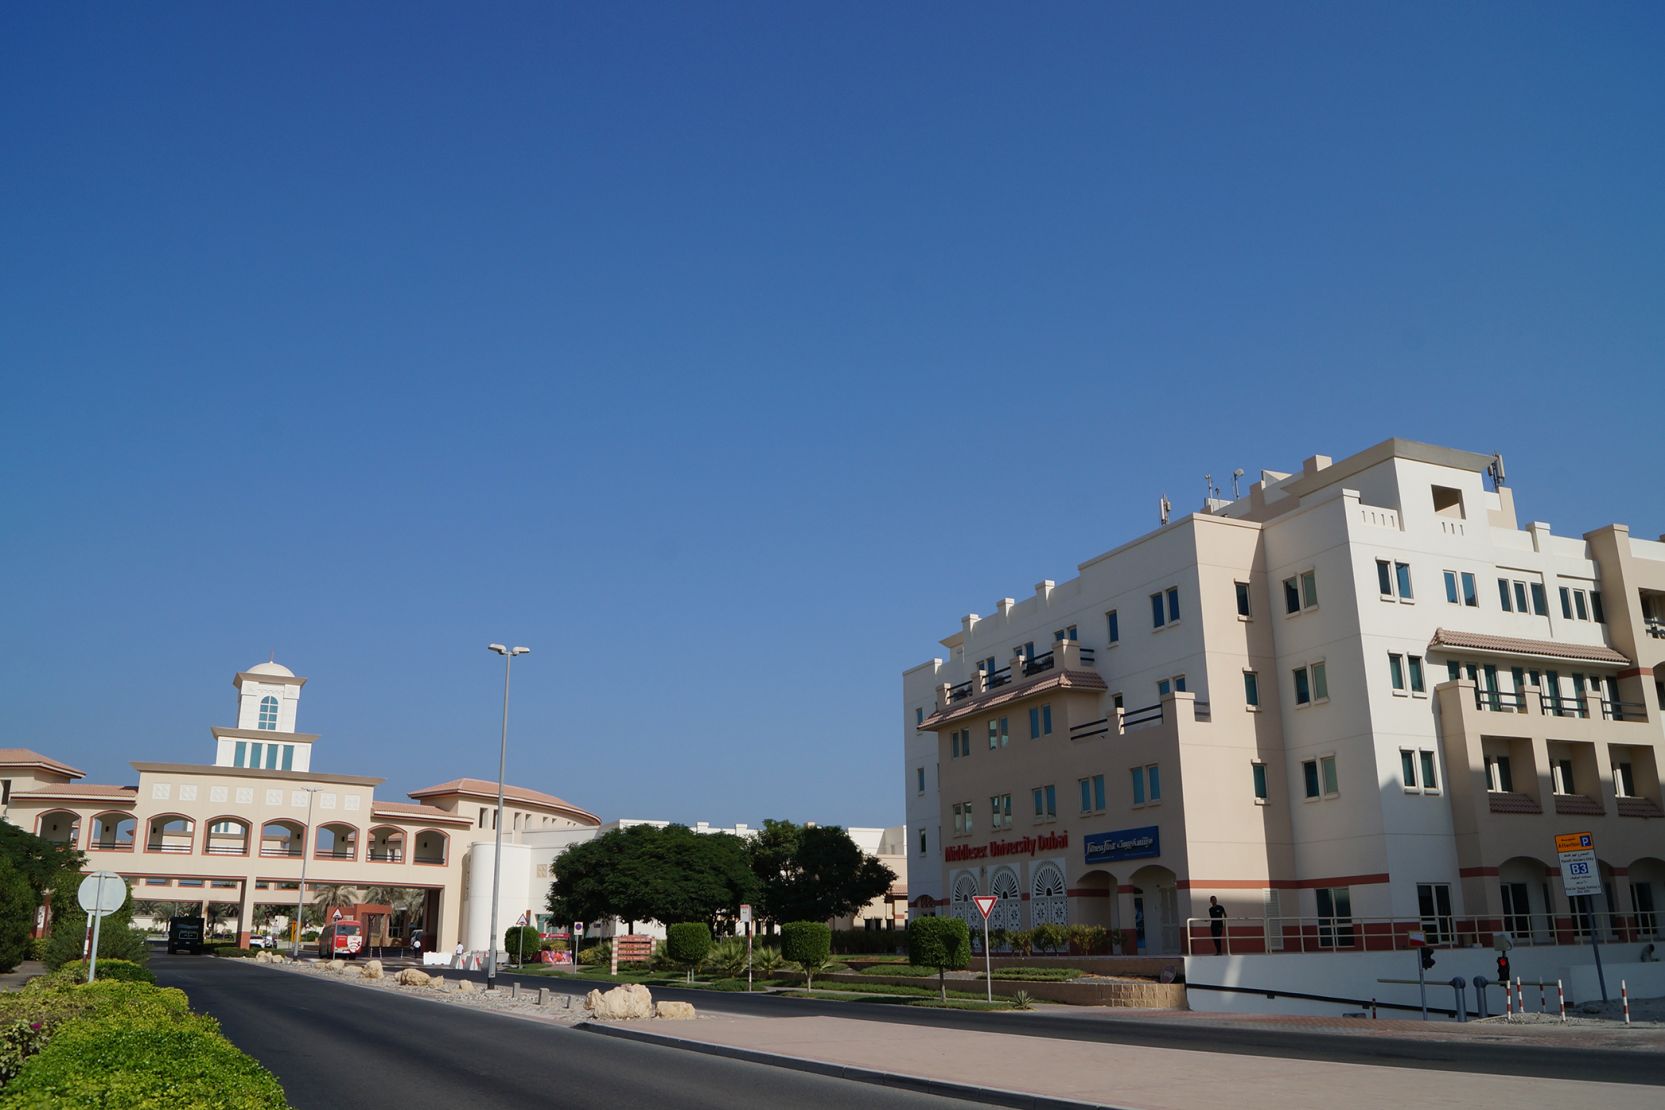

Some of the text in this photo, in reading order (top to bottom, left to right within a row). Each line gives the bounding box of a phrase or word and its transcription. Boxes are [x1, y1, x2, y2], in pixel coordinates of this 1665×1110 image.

[945, 830, 1069, 862] Middlesex University Dubai
[1582, 837, 1589, 847] P
[1571, 863, 1587, 874] B3
